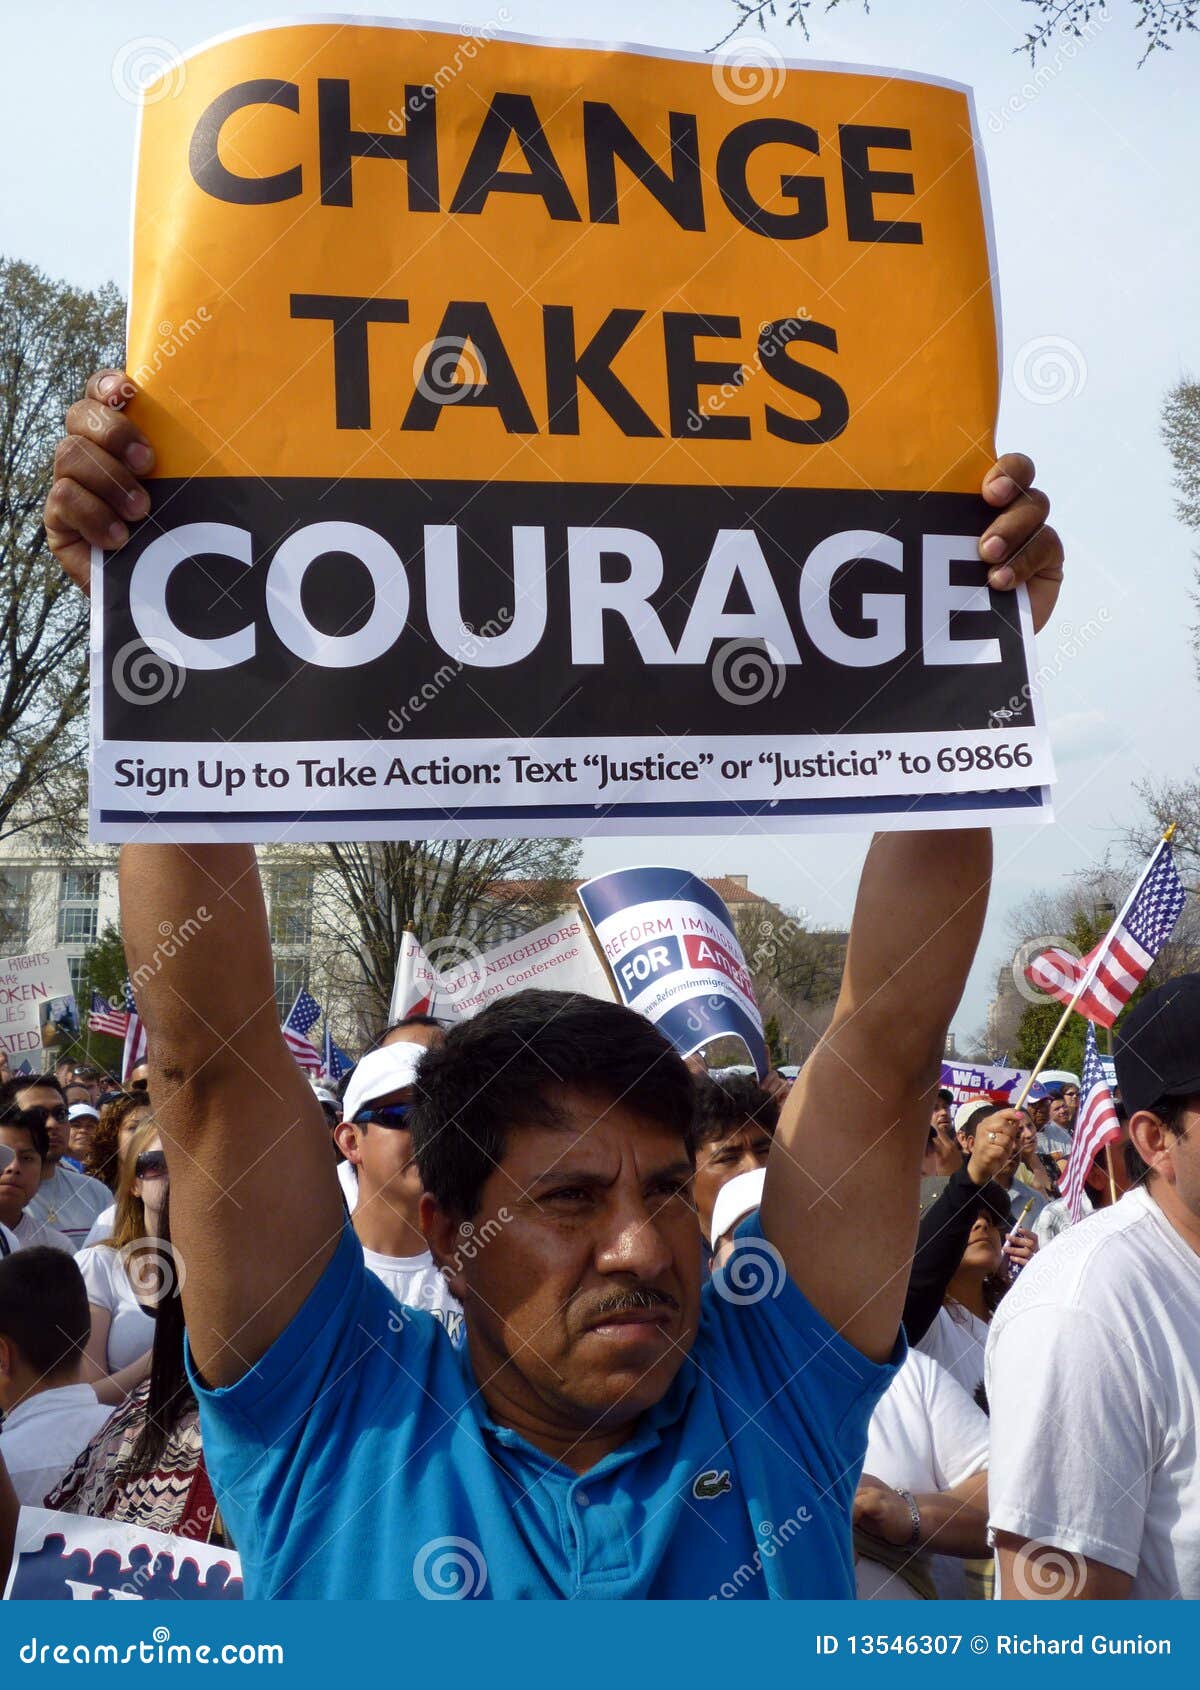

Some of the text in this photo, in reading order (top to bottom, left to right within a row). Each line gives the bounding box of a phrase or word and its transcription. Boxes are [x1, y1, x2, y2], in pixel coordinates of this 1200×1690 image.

[188, 78, 924, 246] CHANGE
[289, 293, 850, 446] TAKES
[129, 520, 1002, 670] COURAGE
[114, 757, 189, 796] Sign
[197, 760, 246, 789] Up
[255, 761, 289, 788] to
[297, 756, 376, 787] Take
[383, 757, 501, 786] Action:
[507, 755, 578, 783] Text
[720, 756, 752, 779] or
[898, 751, 931, 774] to
[937, 742, 1033, 773] 69866
[8, 952, 50, 971] RIGHTS
[446, 969, 482, 995] OUR
[485, 923, 581, 976] NEIGHBORS
[605, 917, 673, 960] REFORM
[506, 947, 579, 986] Conference
[620, 945, 671, 991] FOR
[952, 1069, 981, 1088] We
